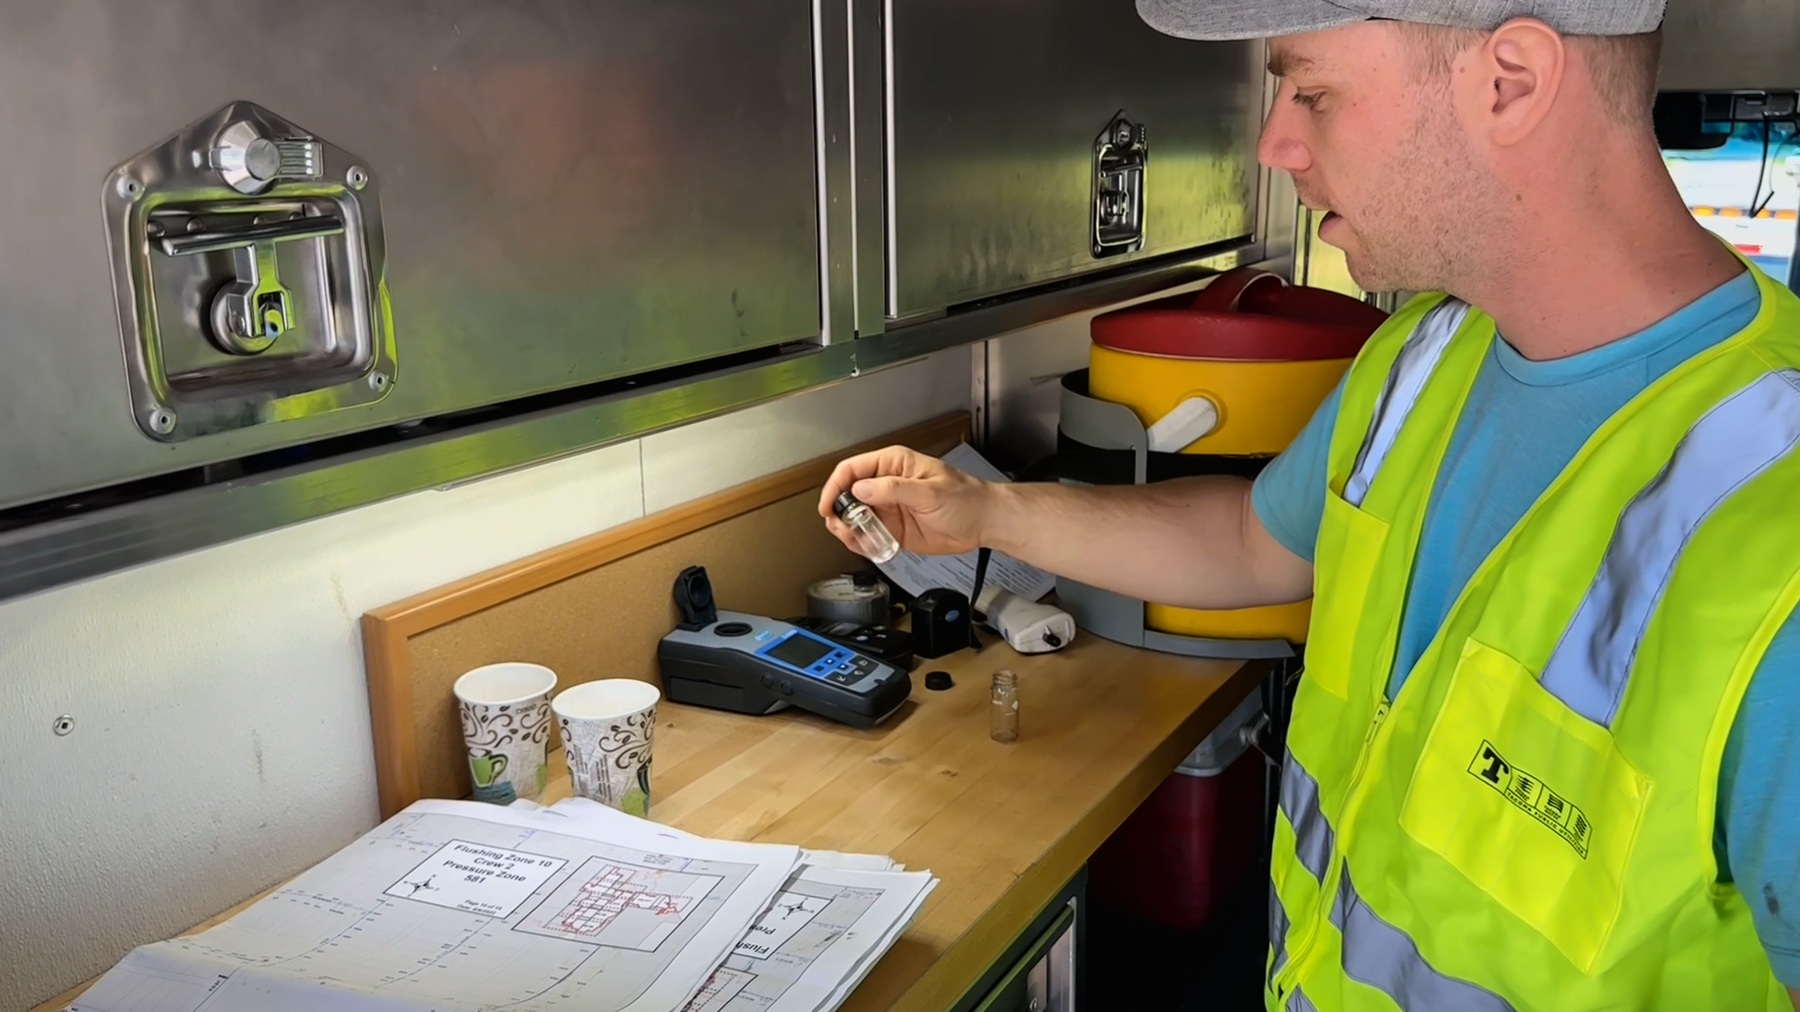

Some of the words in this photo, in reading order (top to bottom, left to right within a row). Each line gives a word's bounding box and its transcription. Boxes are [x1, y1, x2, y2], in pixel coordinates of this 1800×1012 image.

[1481, 746, 1509, 784] T
[454, 844, 504, 860] Flushing
[505, 853, 535, 864] Zone
[538, 860, 553, 868] 10
[473, 857, 504, 868] Crew
[442, 859, 494, 876] Pressure
[495, 870, 526, 882] Zone
[463, 874, 487, 884] 581
